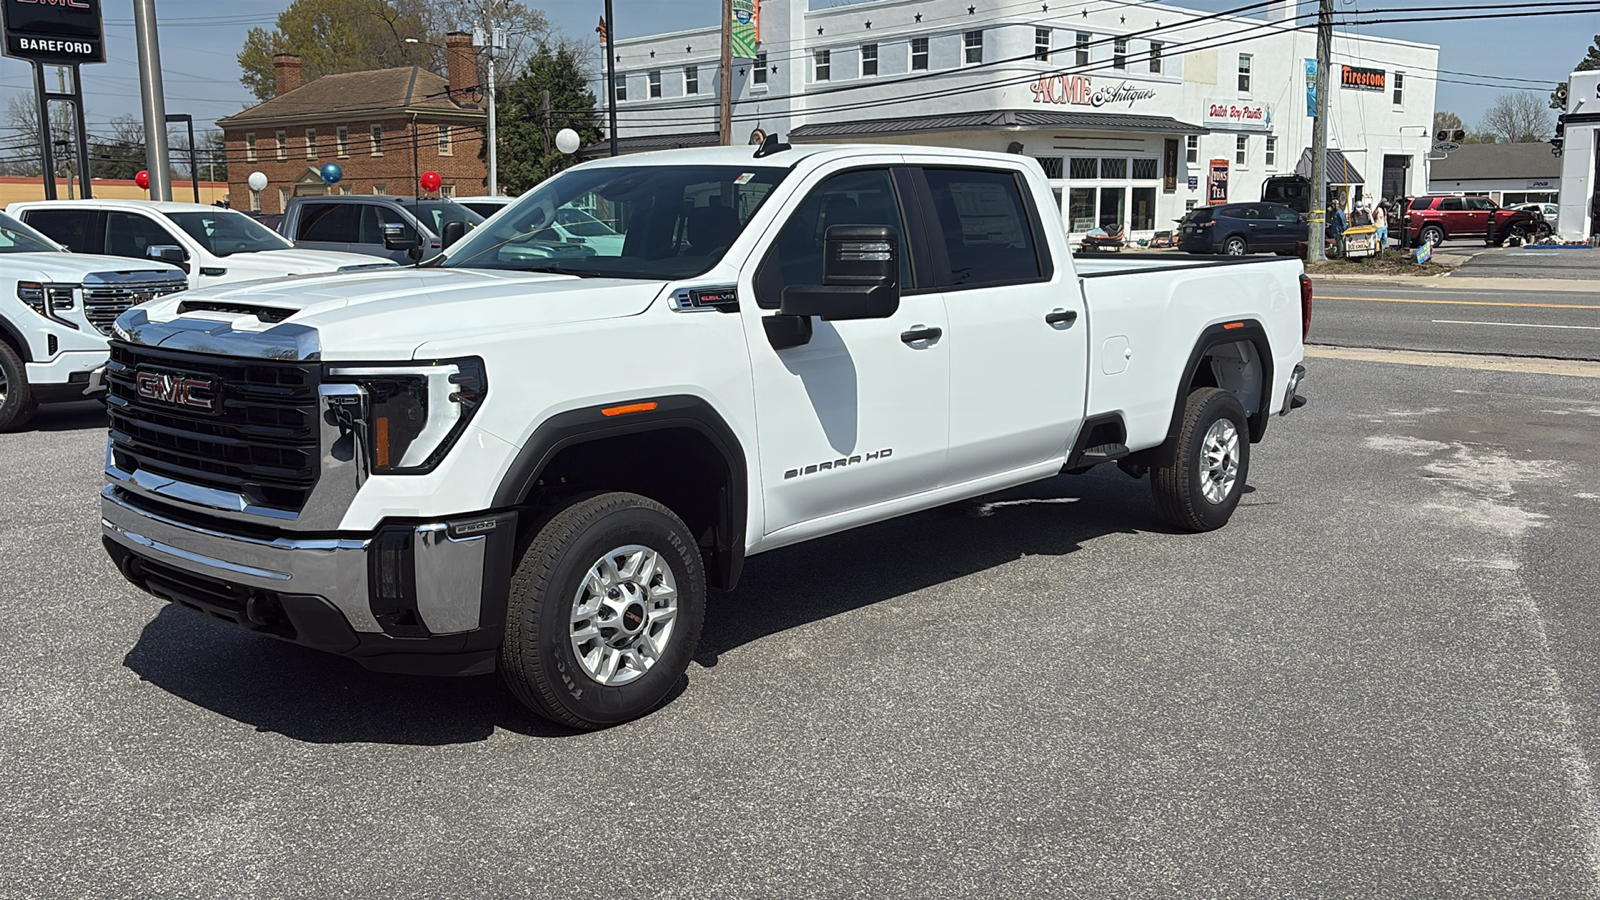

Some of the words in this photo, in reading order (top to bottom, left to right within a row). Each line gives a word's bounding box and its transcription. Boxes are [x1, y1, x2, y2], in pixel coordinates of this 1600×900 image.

[20, 38, 92, 54] BAREFORD
[1342, 66, 1385, 87] Firestone
[1030, 74, 1092, 105] ACME
[1091, 80, 1157, 108] Antiques
[1209, 104, 1228, 117] Dutch
[1229, 105, 1242, 121] Boy
[1242, 106, 1263, 120] Paints
[1212, 186, 1226, 198] TEA
[137, 371, 212, 408] GMC
[784, 455, 862, 479] SIERRA
[866, 448, 893, 461] HD
